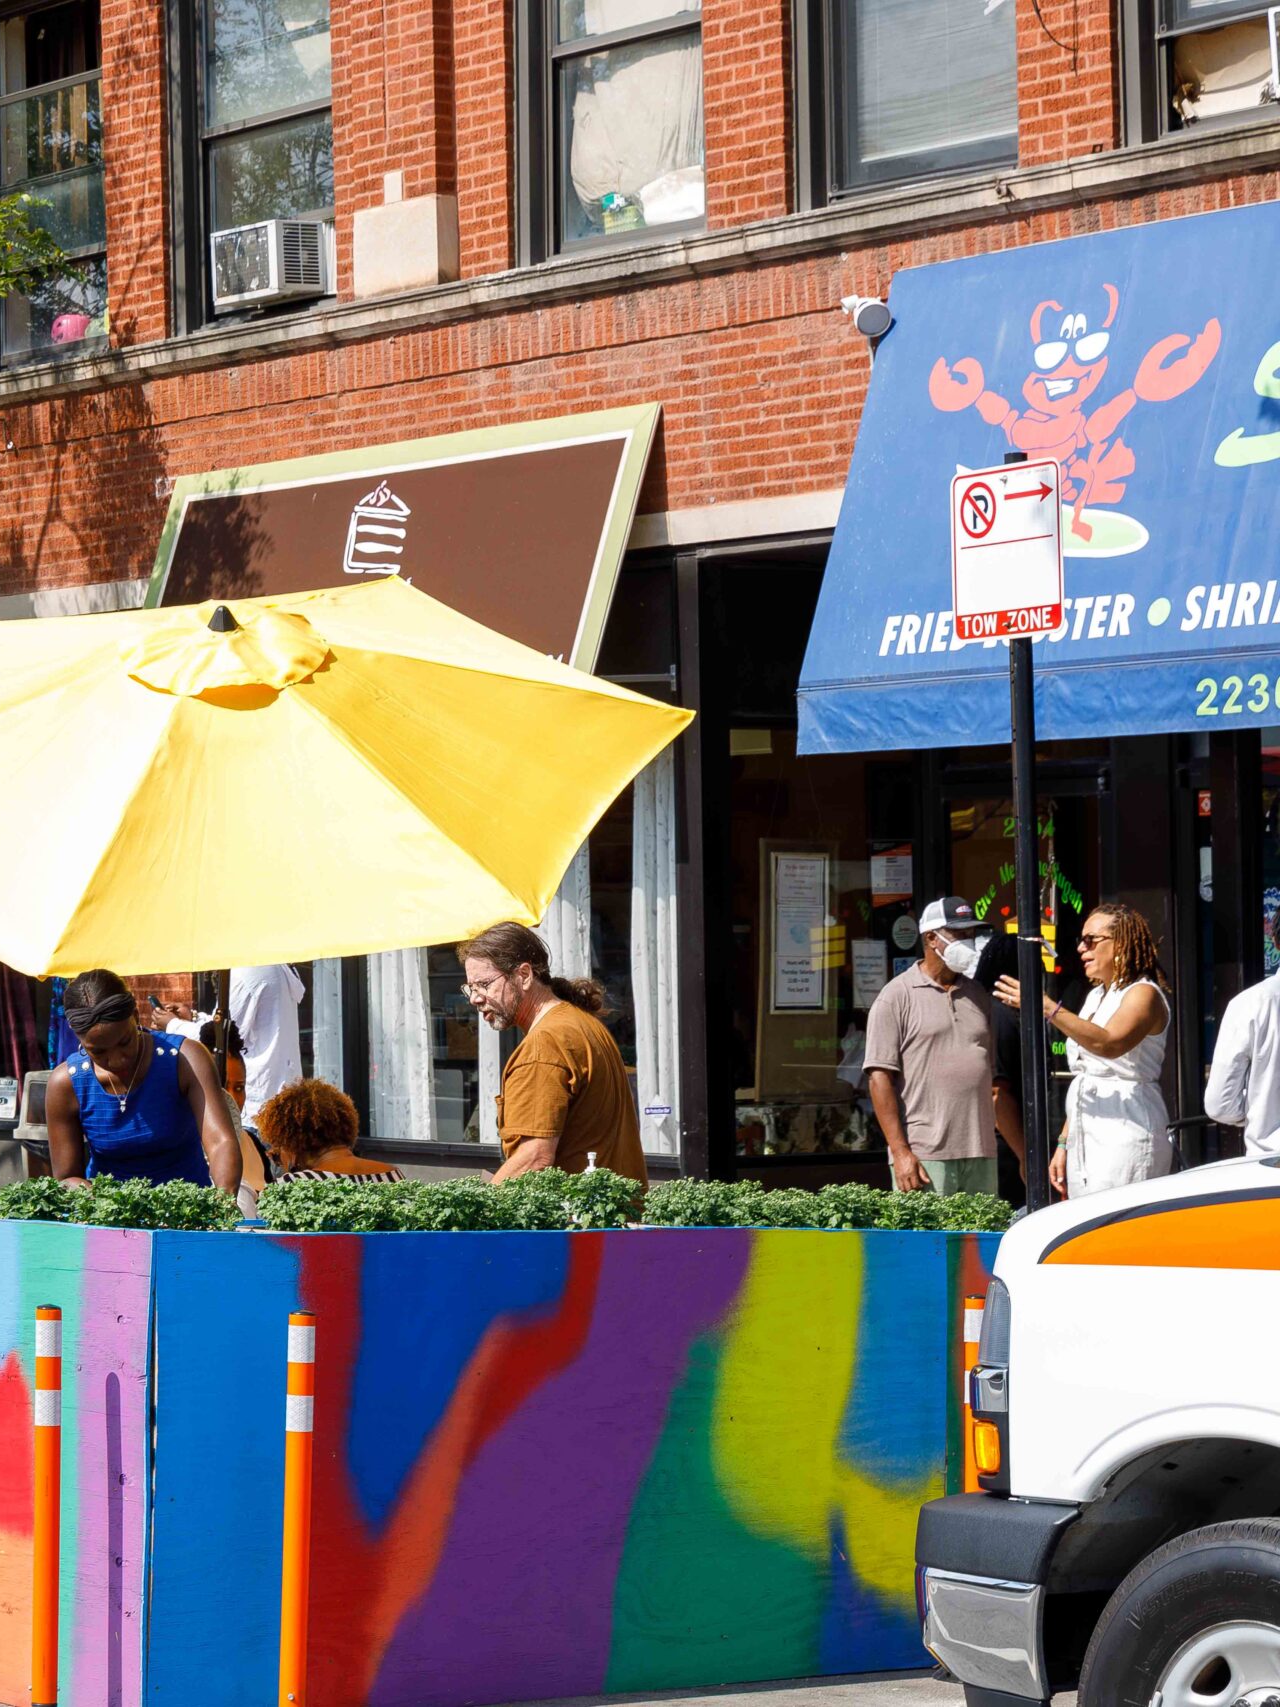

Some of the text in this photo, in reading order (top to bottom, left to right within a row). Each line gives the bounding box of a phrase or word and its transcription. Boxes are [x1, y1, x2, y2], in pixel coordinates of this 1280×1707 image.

[878, 609, 965, 657] FRIE
[1180, 579, 1280, 632] SHRI
[961, 607, 1053, 637] TOW ZONE
